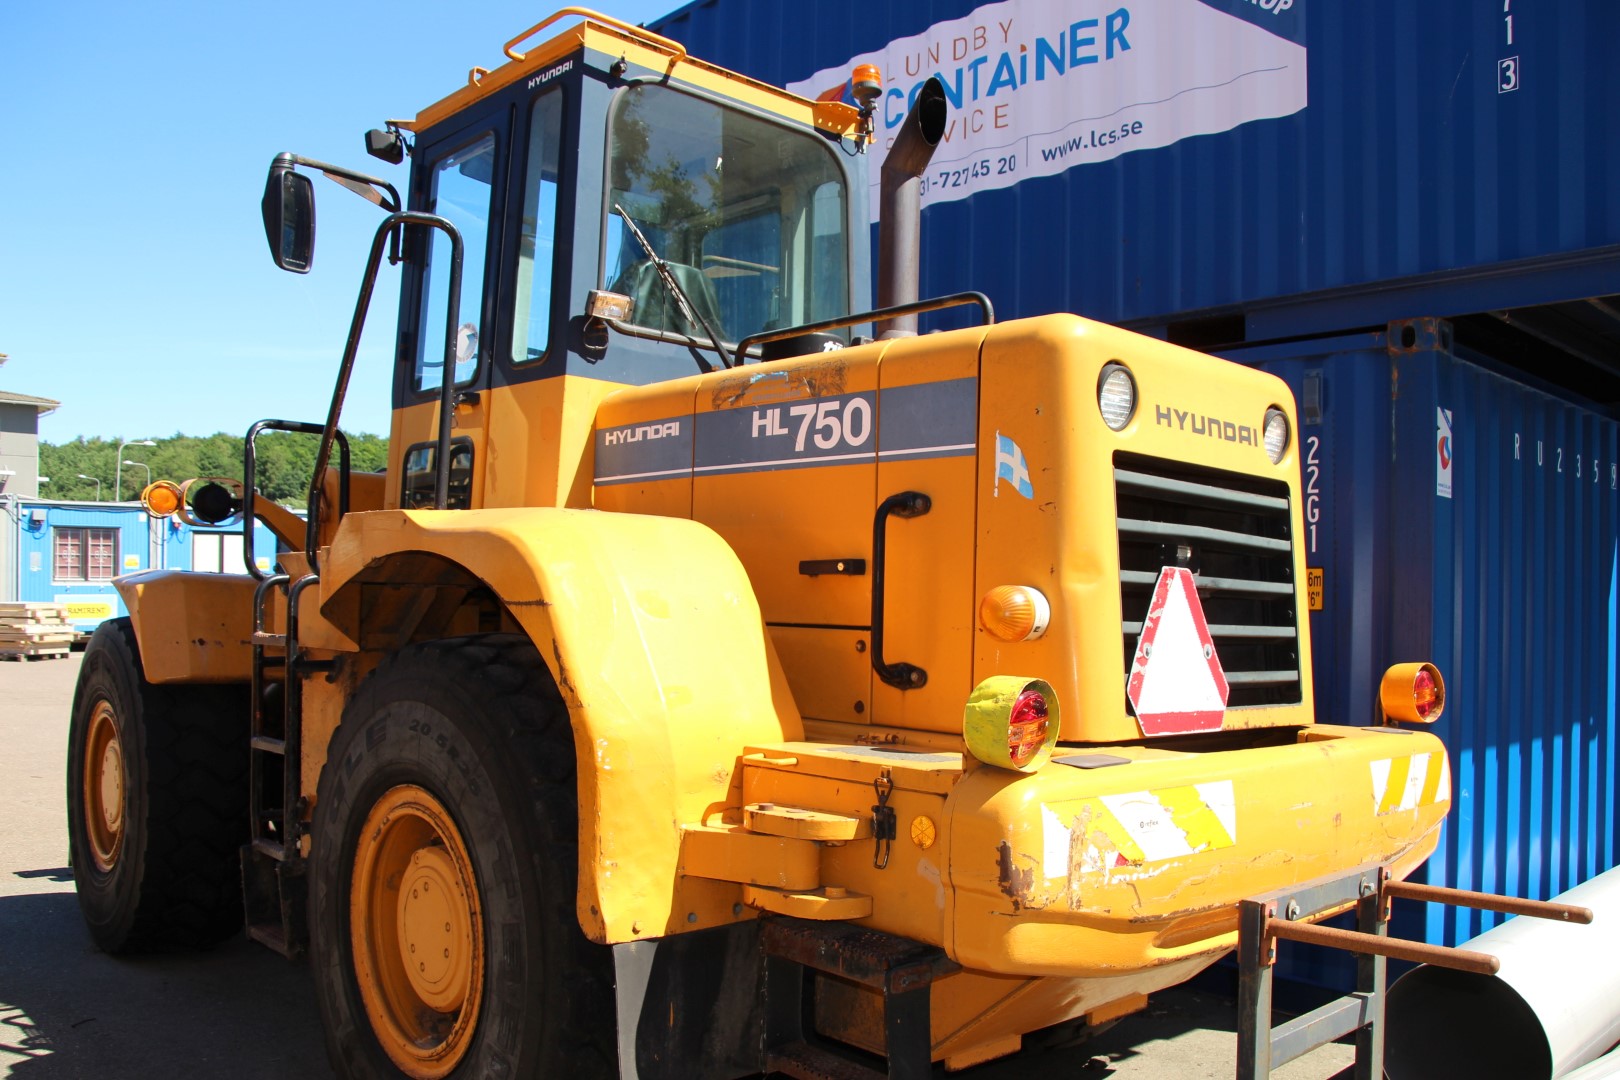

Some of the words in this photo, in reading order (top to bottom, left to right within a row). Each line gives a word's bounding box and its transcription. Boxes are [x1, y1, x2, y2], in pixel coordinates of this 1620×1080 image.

[886, 18, 1013, 83] LUNDBY
[528, 59, 573, 90] HYUNDAI
[1041, 120, 1143, 162] www.lcs.se
[604, 421, 681, 446] HYUNDAI
[1155, 404, 1258, 447] HYUNDAI
